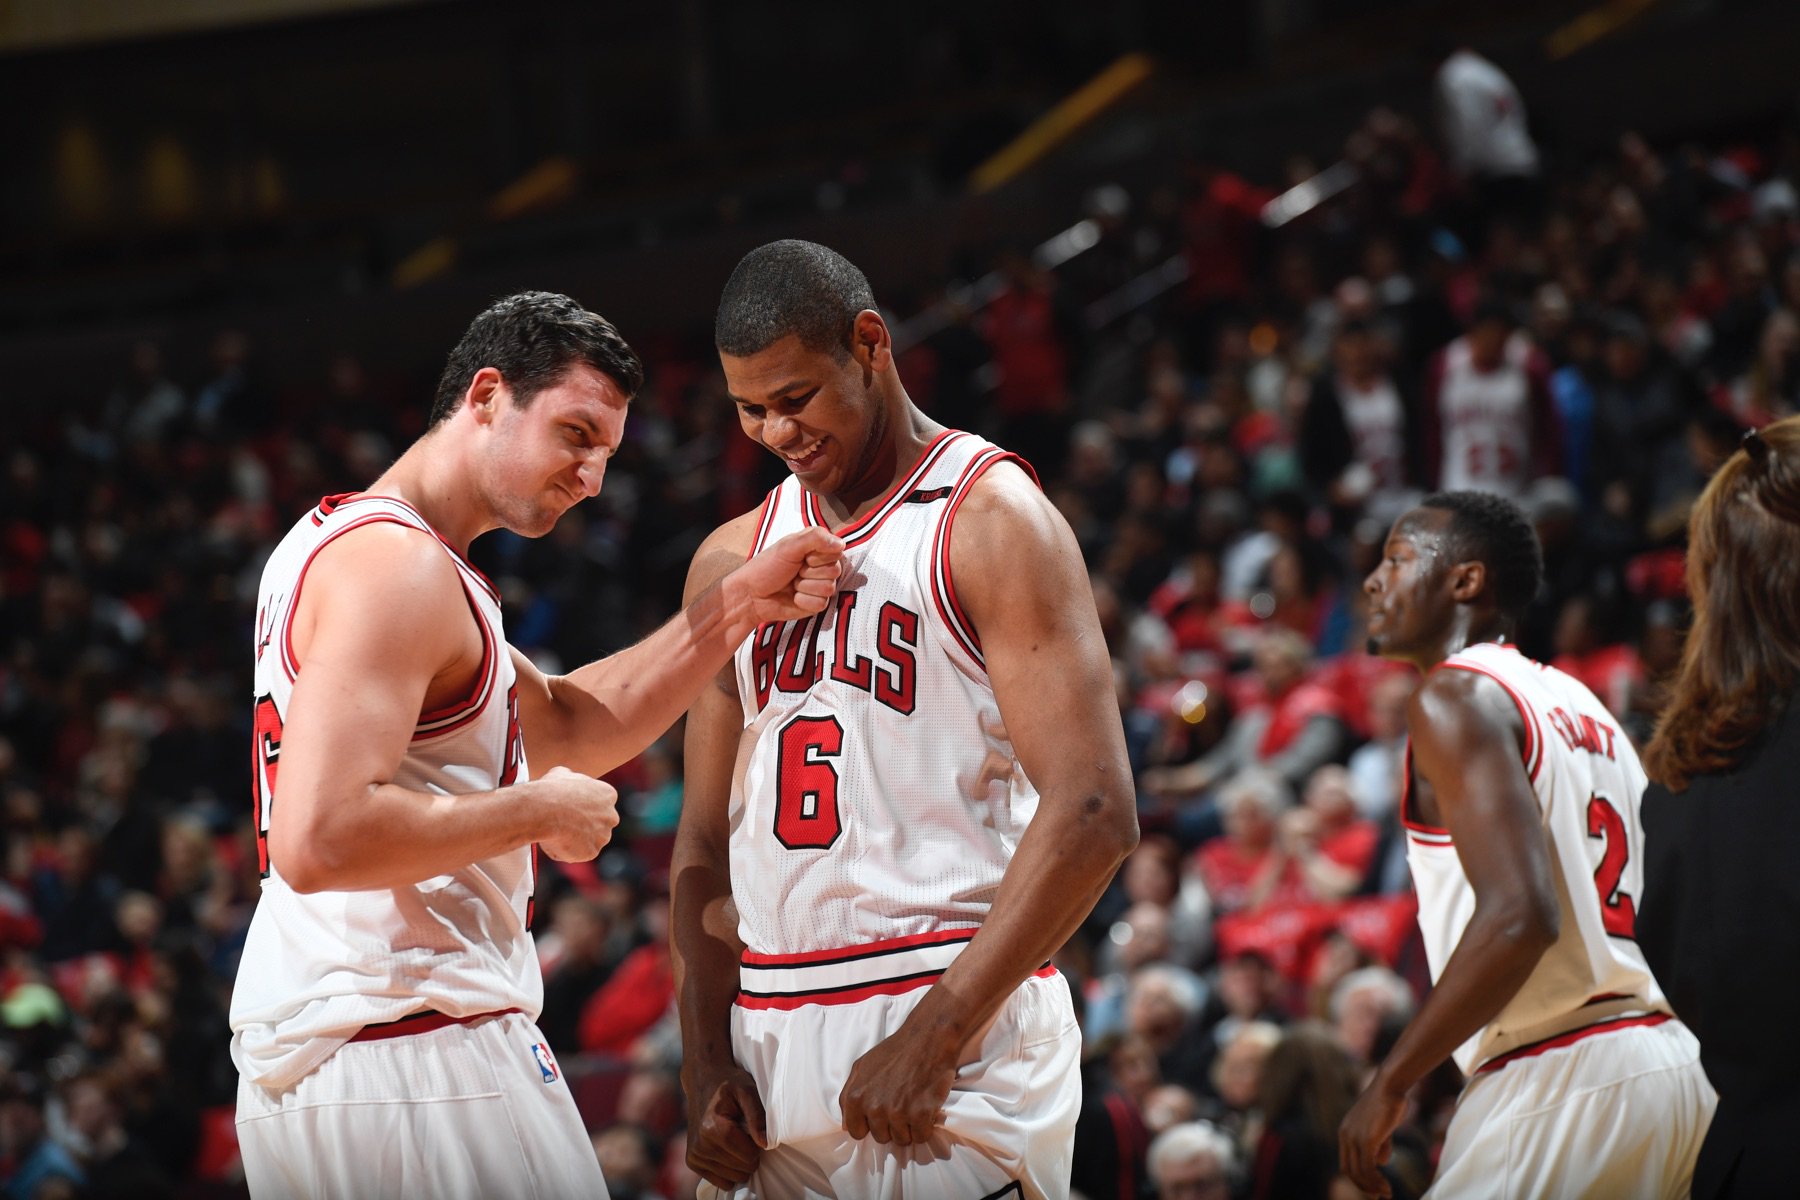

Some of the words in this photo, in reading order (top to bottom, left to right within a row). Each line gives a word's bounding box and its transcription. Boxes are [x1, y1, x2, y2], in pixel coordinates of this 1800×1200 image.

[752, 591, 918, 716] BULS
[773, 714, 844, 851] 6
[1587, 793, 1637, 940] 2
